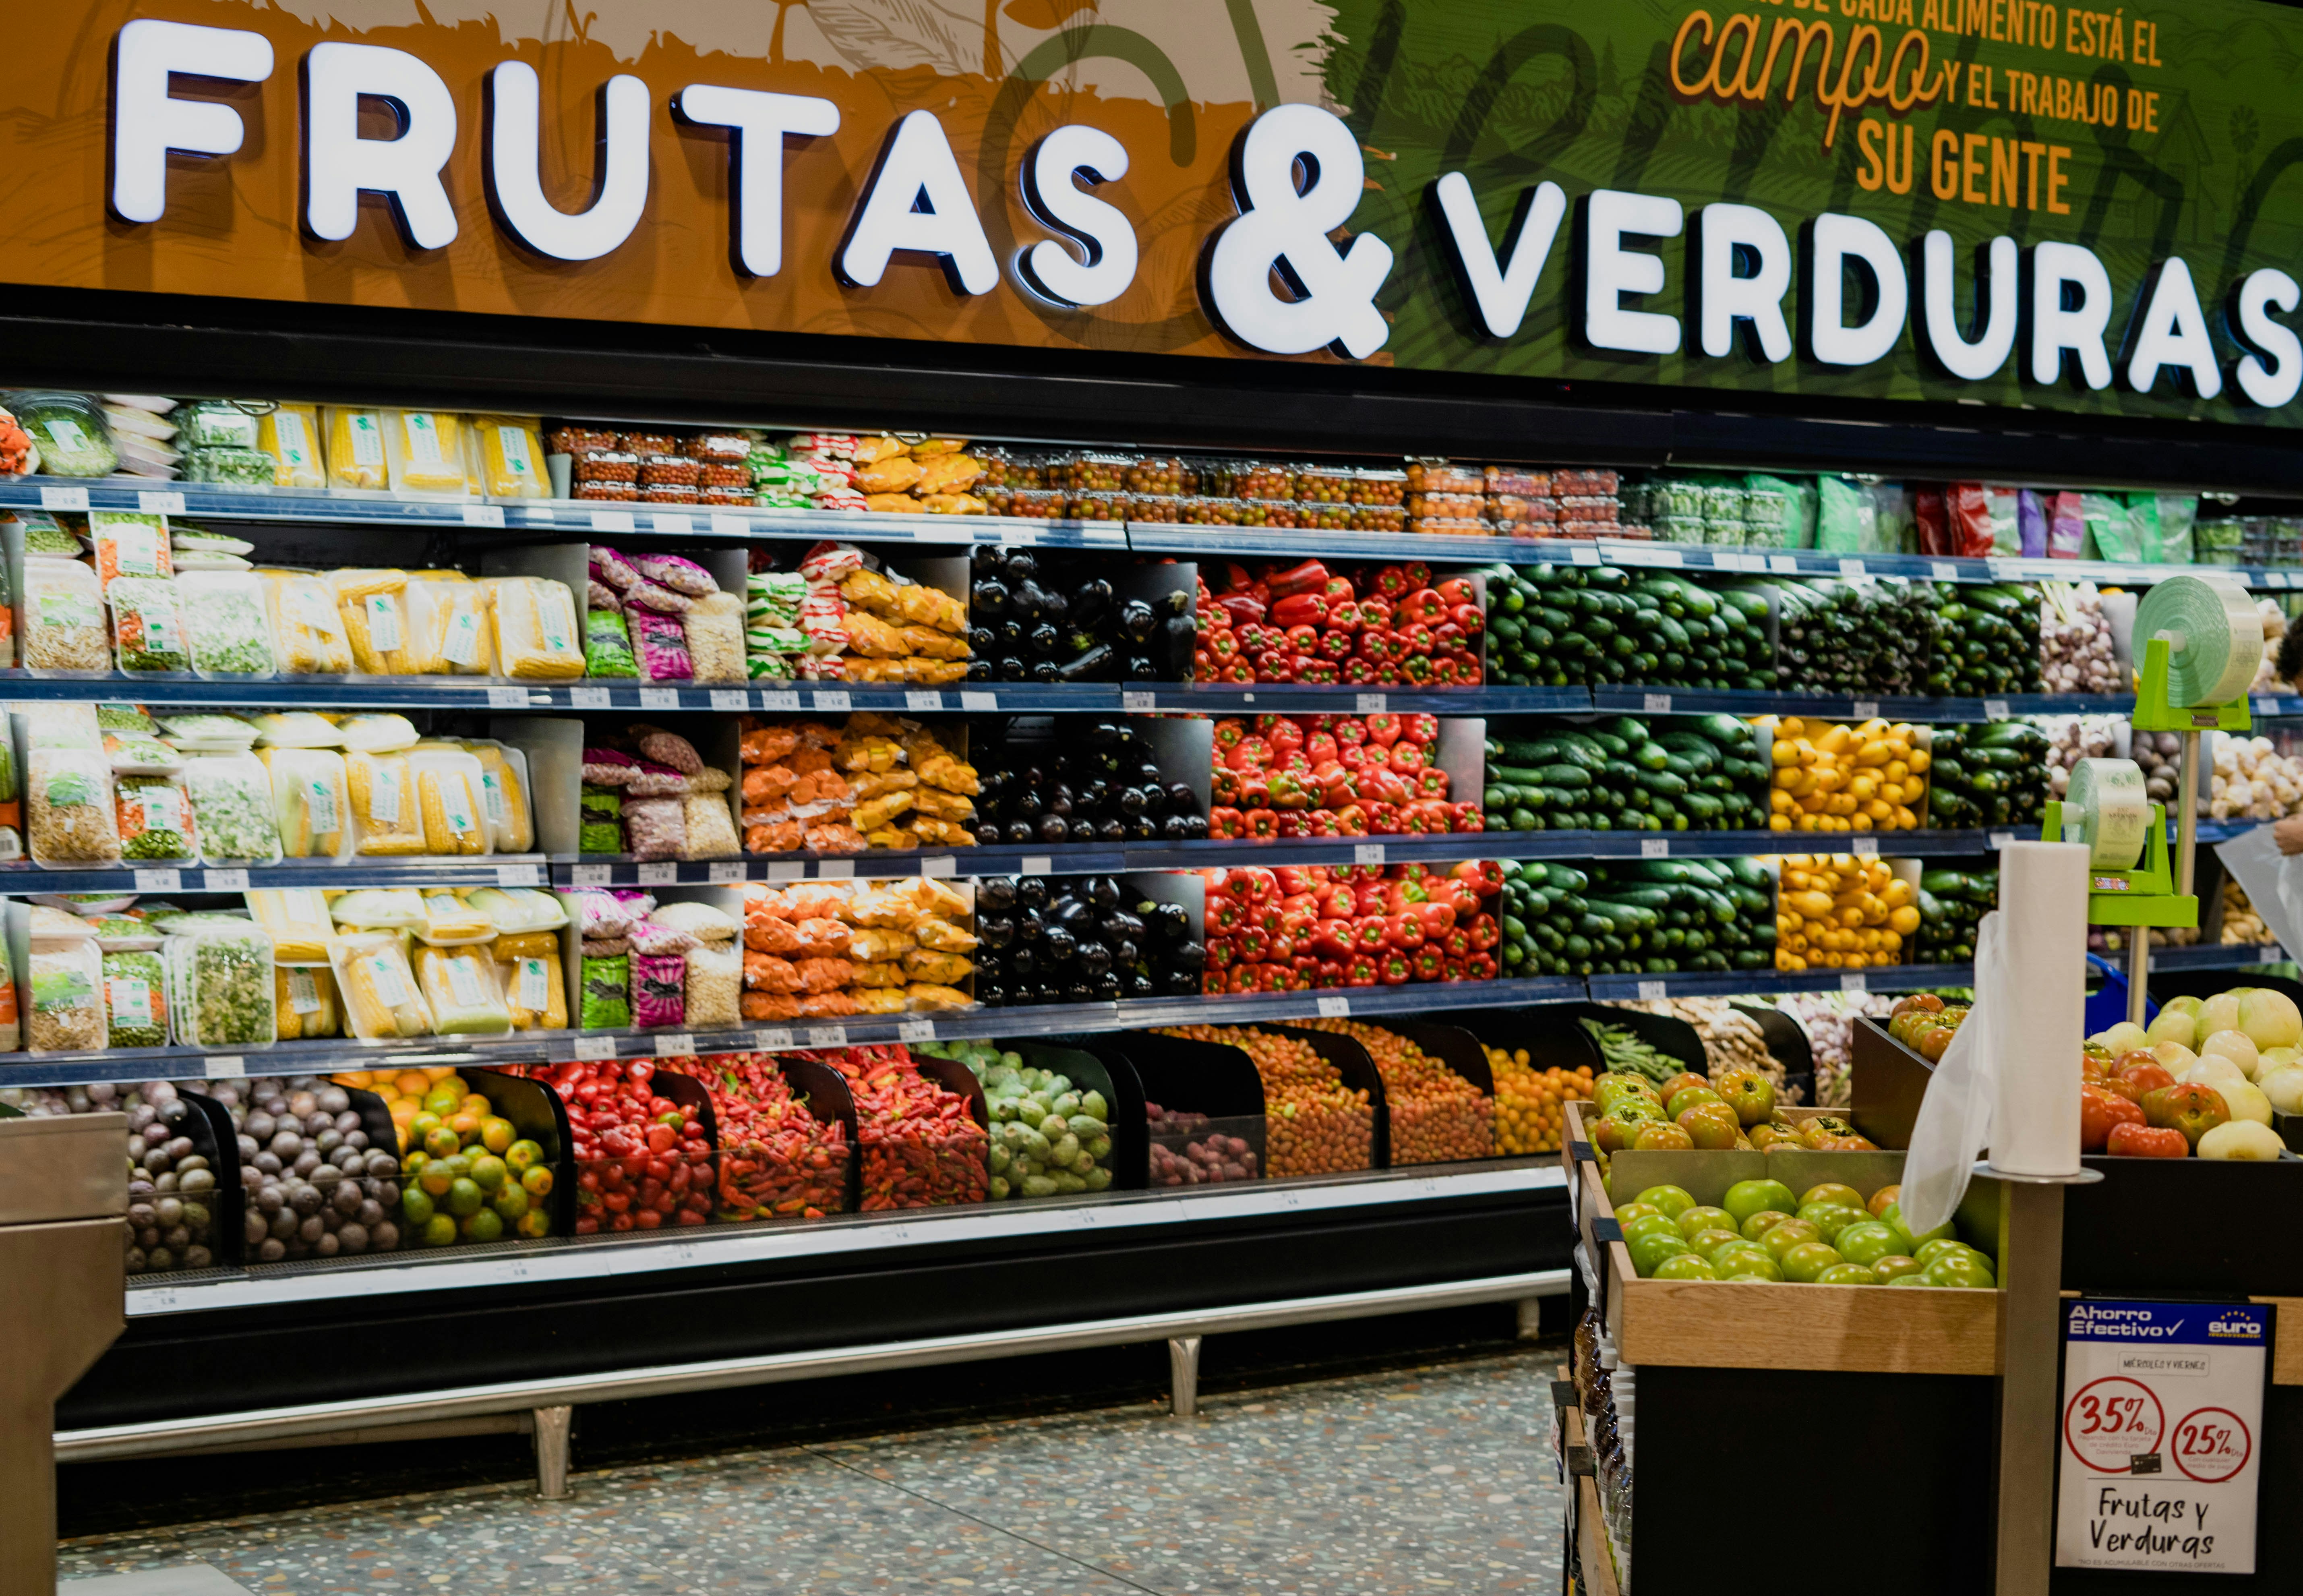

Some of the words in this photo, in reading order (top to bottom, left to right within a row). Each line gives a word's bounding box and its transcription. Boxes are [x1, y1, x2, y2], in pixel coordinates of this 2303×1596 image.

[1922, 0, 2057, 50] ALIMENTO
[2066, 5, 2124, 60] ESTÁ
[2133, 21, 2161, 67] EL
[1670, 10, 1944, 147] campo
[1943, 60, 1960, 102] Y
[1968, 64, 1998, 109] EL
[2005, 70, 2117, 126] TRABAJO
[2128, 90, 2158, 132] DE
[1857, 119, 1913, 194] SU
[1932, 130, 2071, 214] GENTE
[115, 19, 1138, 306] FRUTAS
[1210, 103, 1393, 360] &
[1437, 172, 2303, 407] VERDURAS
[2069, 1305, 2152, 1321] Ahorro
[2069, 1320, 2163, 1337] Efectivo
[2208, 1321, 2261, 1334] euro
[2173, 1360, 2206, 1370] VIERNES
[2080, 1395, 2145, 1435] 35%
[2181, 1424, 2232, 1455] 25%
[2099, 1487, 2185, 1524] Frutas
[2090, 1518, 2214, 1560] Verduras
